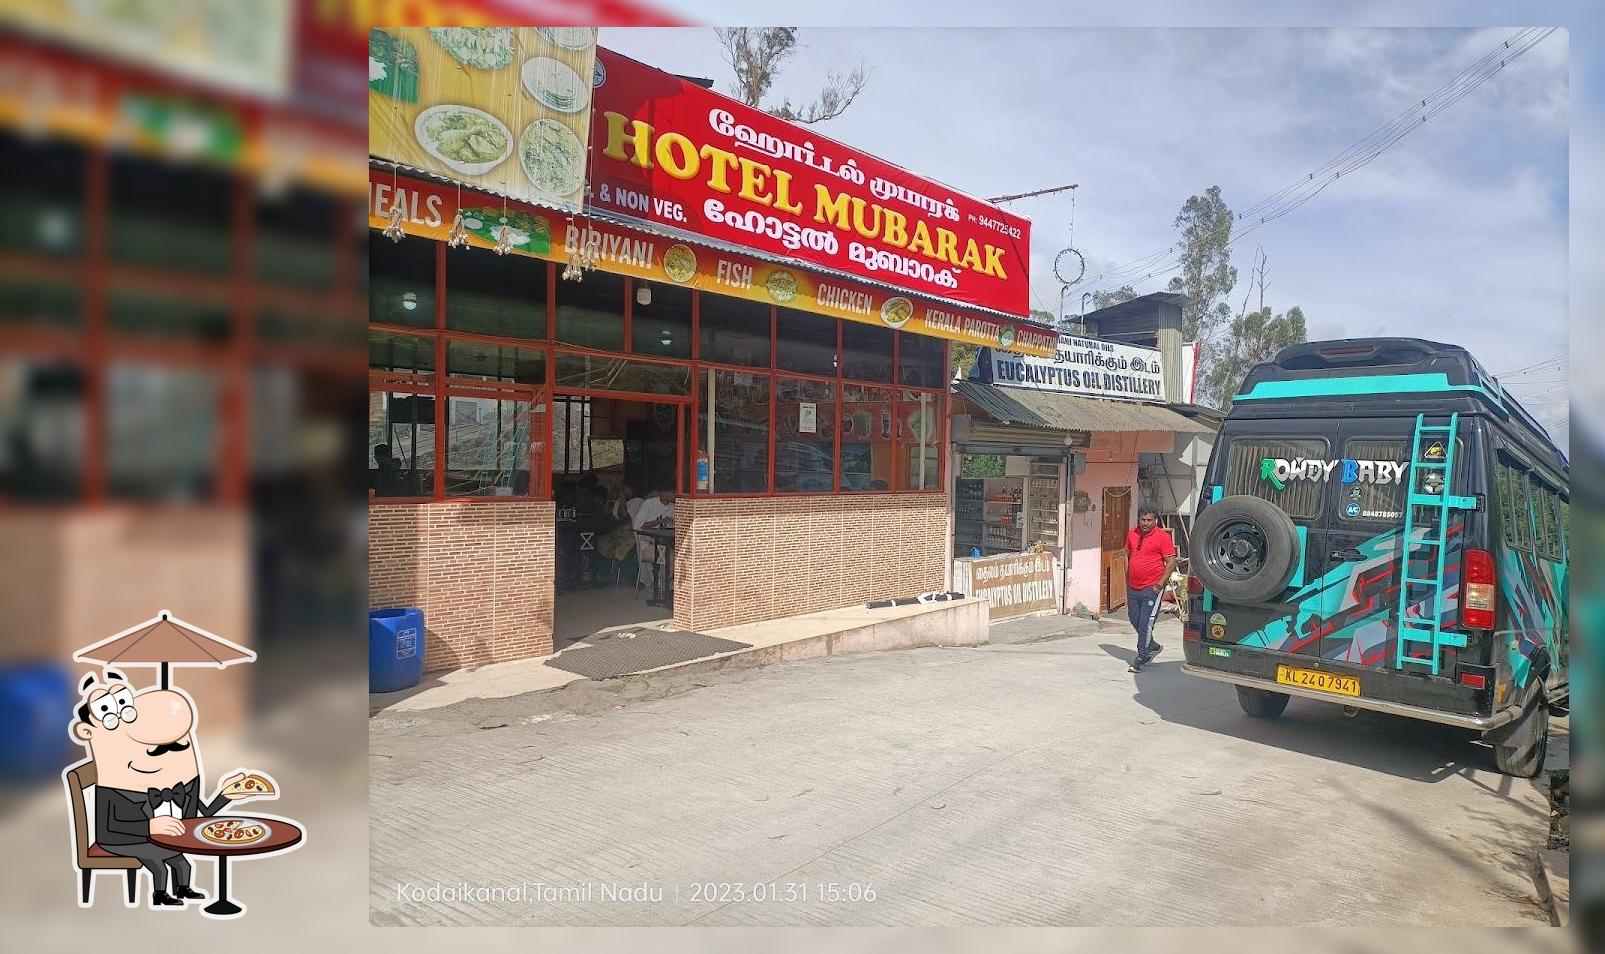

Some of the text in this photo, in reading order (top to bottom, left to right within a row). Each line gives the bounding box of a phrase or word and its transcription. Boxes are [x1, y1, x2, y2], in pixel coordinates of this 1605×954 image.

[708, 107, 960, 222] ஹோட்டல் முபாரக்
[600, 183, 611, 202] &
[616, 187, 649, 213] NON
[653, 198, 687, 223] VEG.
[602, 111, 1008, 280] HOTEL MUBARAK
[703, 199, 839, 255] ഹോട്ടൽ
[564, 224, 654, 269] BIRIYANI
[716, 259, 753, 290] FISH
[817, 283, 873, 316] CHICKEN
[925, 309, 1000, 341] KERALA PAROTTA
[1073, 338, 1100, 350] NATURAL
[996, 359, 1161, 396] EUCALYPTUS OIL DISTILLERY
[1260, 457, 1410, 491] ROWDY BABY
[1328, 677, 1356, 692] 7941
